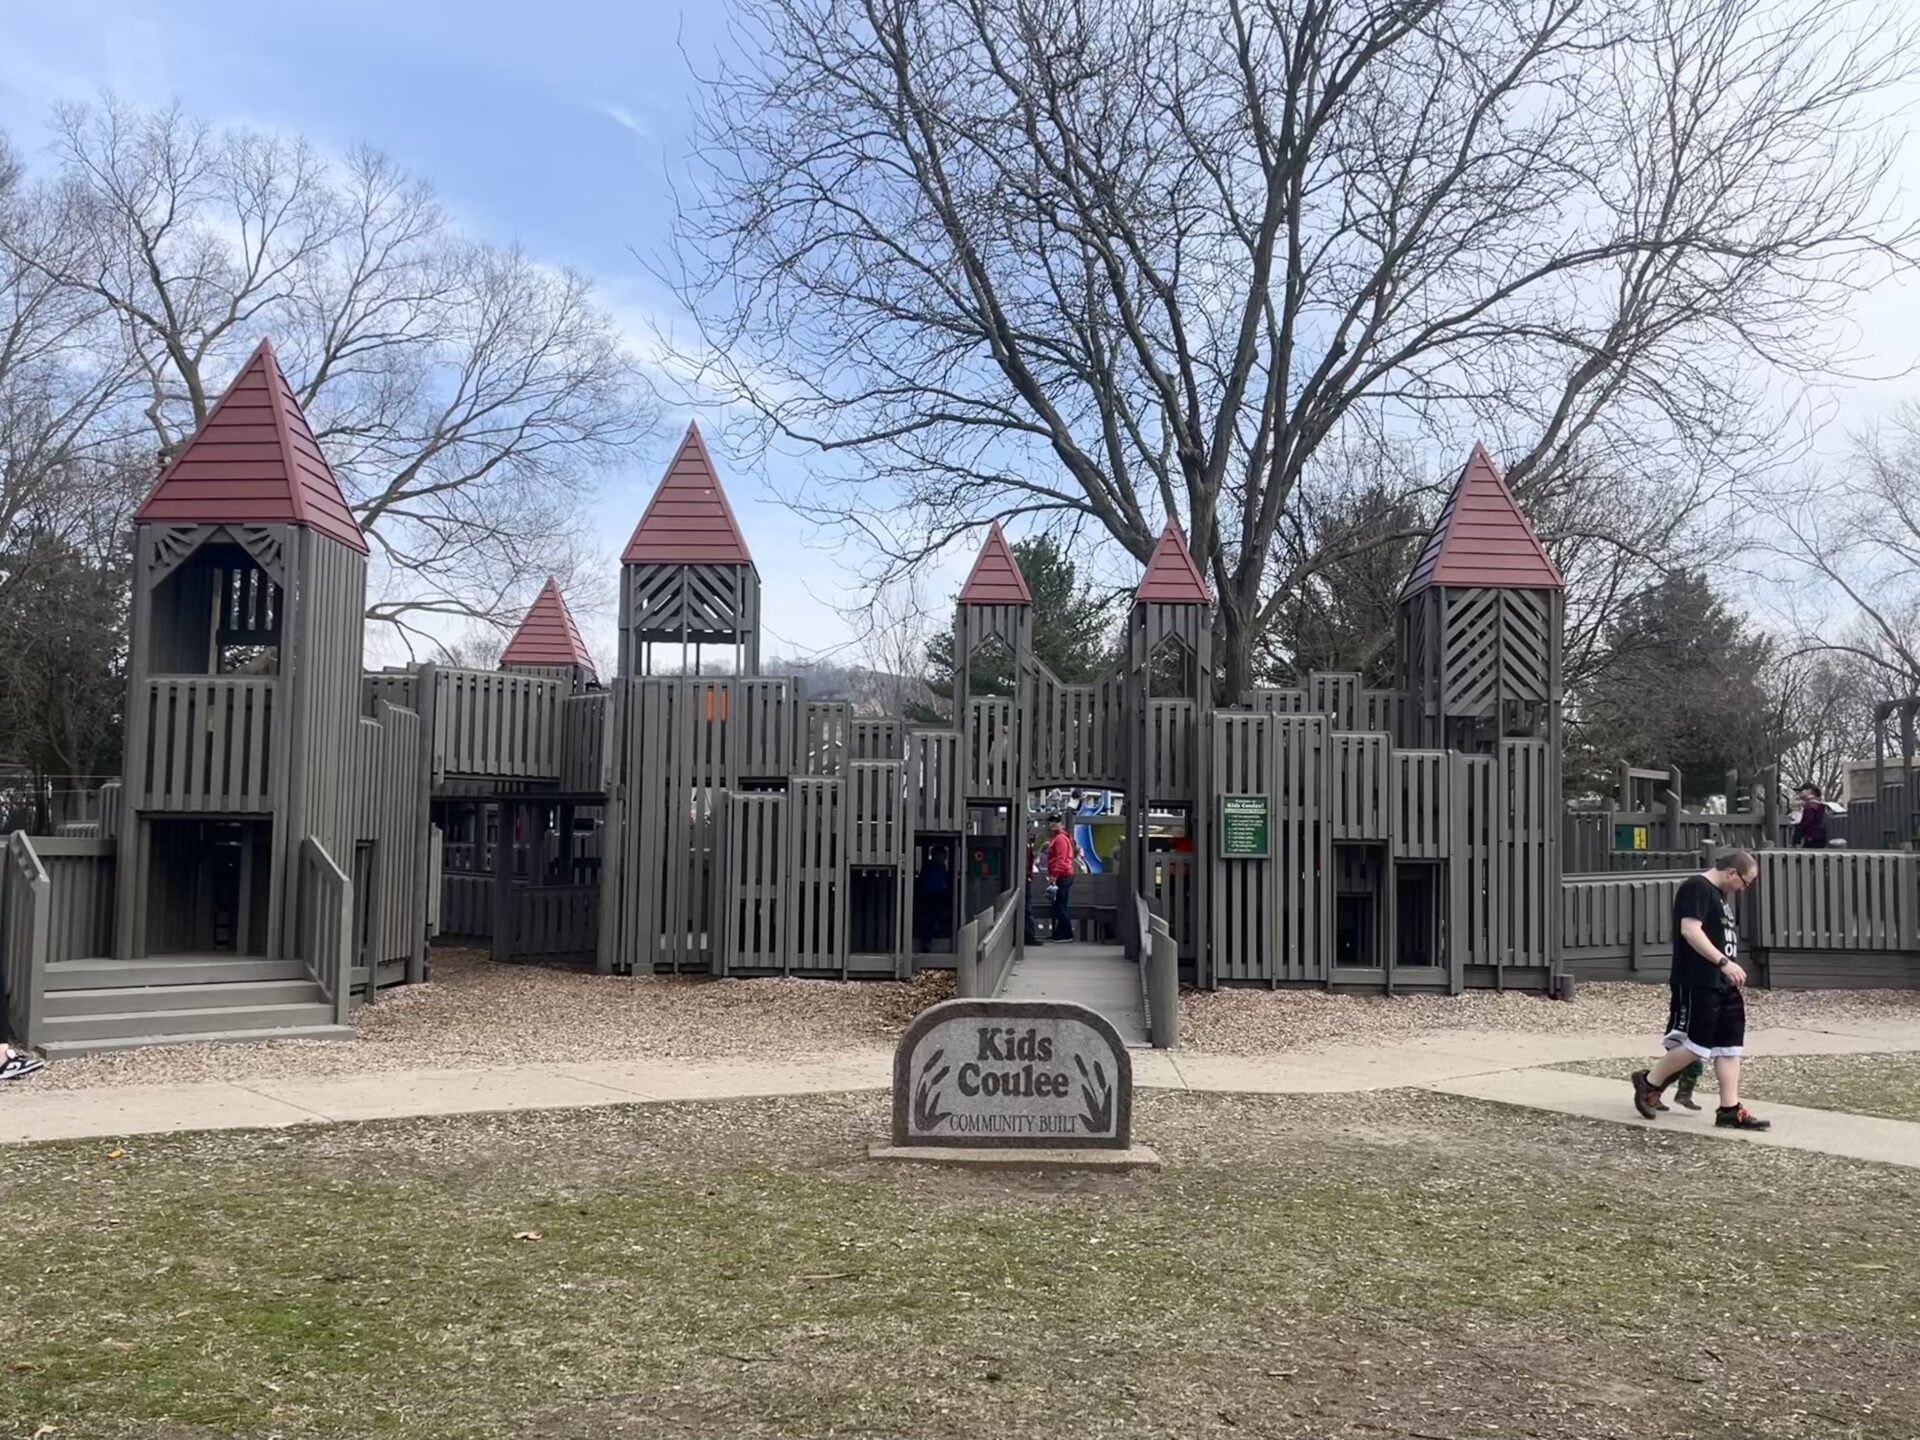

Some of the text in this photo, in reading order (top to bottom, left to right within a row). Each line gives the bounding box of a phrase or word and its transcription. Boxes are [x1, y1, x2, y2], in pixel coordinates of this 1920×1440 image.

[977, 1028, 1053, 1061] Kids
[958, 1063, 1069, 1097] Coulee
[950, 1114, 1078, 1132] COMMUNITY BUILT
